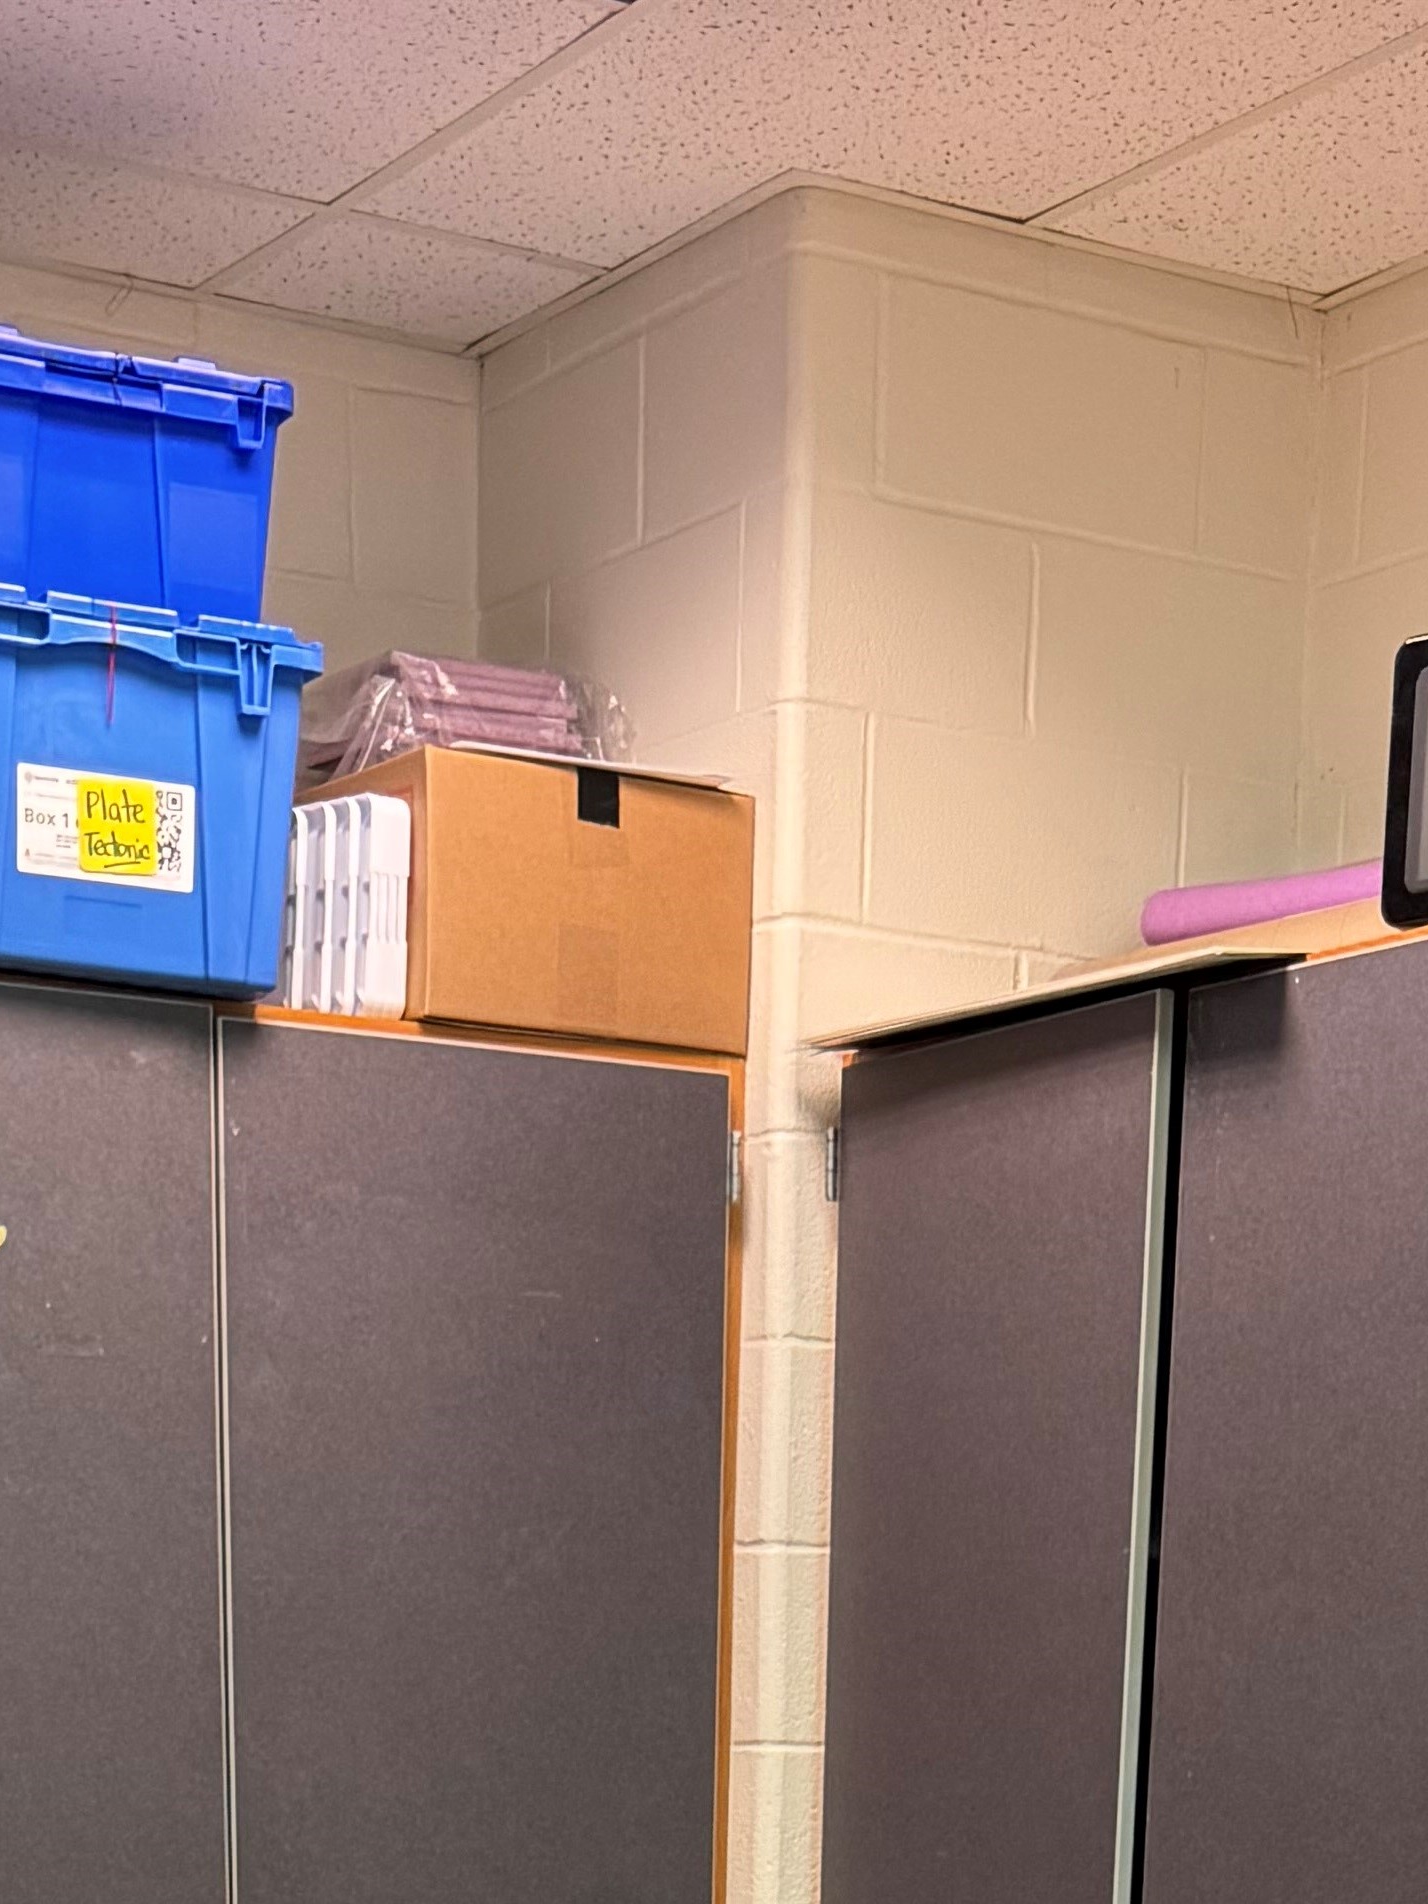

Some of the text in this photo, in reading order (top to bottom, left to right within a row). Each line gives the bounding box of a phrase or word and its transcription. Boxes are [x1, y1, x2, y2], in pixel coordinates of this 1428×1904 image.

[24, 807, 69, 828] Box 1
[86, 789, 145, 824] Plate
